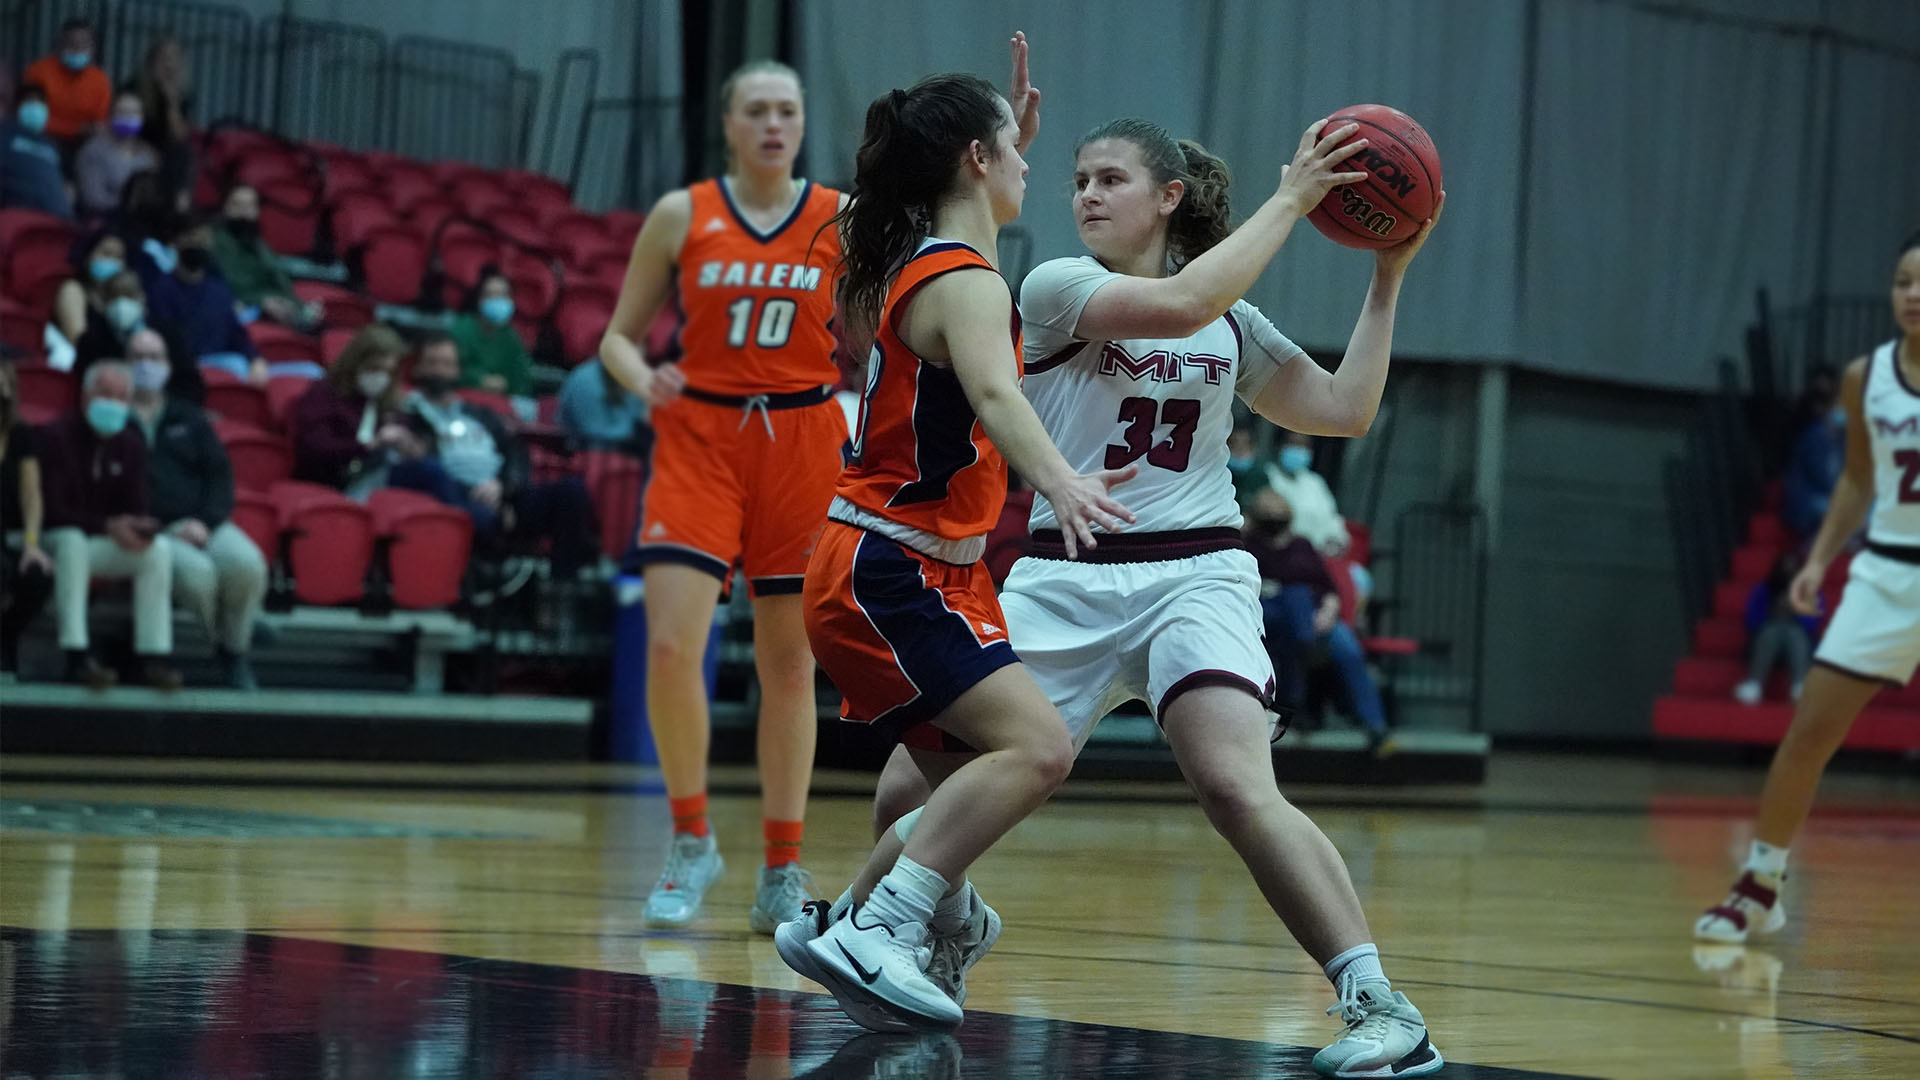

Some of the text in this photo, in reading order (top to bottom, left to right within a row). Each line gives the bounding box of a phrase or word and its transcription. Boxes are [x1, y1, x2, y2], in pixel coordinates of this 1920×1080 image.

[1331, 184, 1397, 236] Wils
[698, 260, 822, 291] SALEM
[728, 297, 797, 349] 10
[1099, 341, 1233, 386] MIT
[1104, 396, 1202, 473] 33
